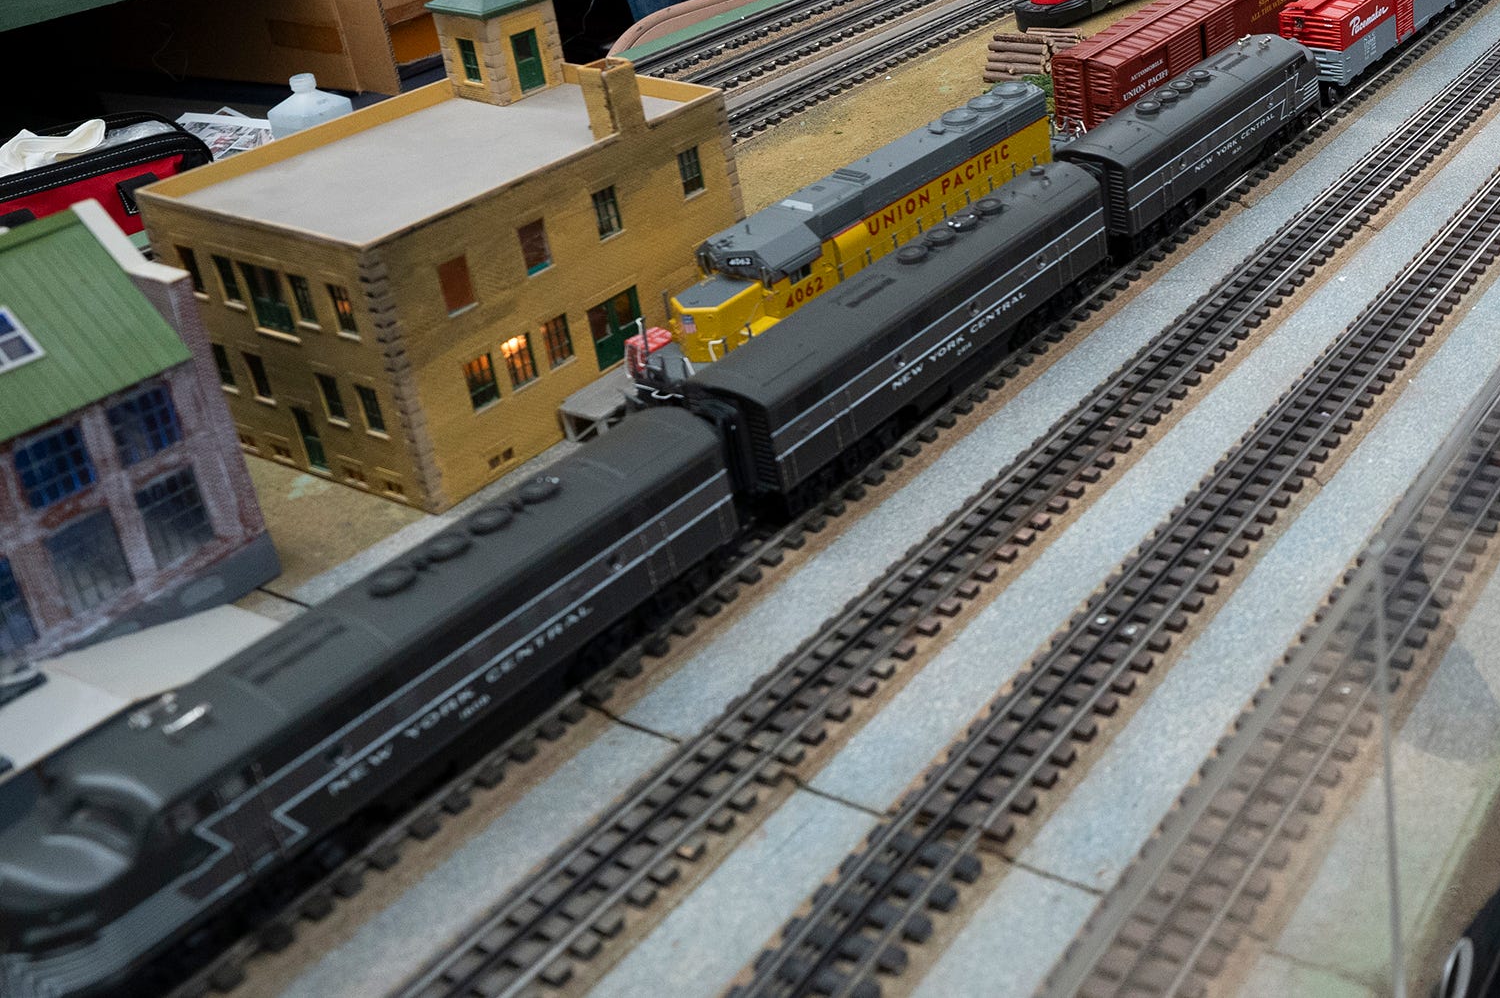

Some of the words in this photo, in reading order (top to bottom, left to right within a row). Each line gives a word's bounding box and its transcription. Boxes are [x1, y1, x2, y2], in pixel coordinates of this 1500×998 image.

[1349, 5, 1389, 36] Pacemaker
[1123, 82, 1146, 101] UNION
[1194, 155, 1213, 173] NEW
[1216, 138, 1237, 156] YORK
[1241, 113, 1275, 140] CENTRAL
[868, 189, 931, 236] UNION
[941, 144, 1010, 195] PACIFIC
[785, 276, 824, 308] 4062
[892, 362, 924, 390] NEW
[929, 334, 965, 362] YORK
[970, 292, 1026, 333] CENTRAL
[328, 743, 393, 796] NEW
[404, 688, 475, 739] YORK
[485, 605, 595, 683] CENTRAL
